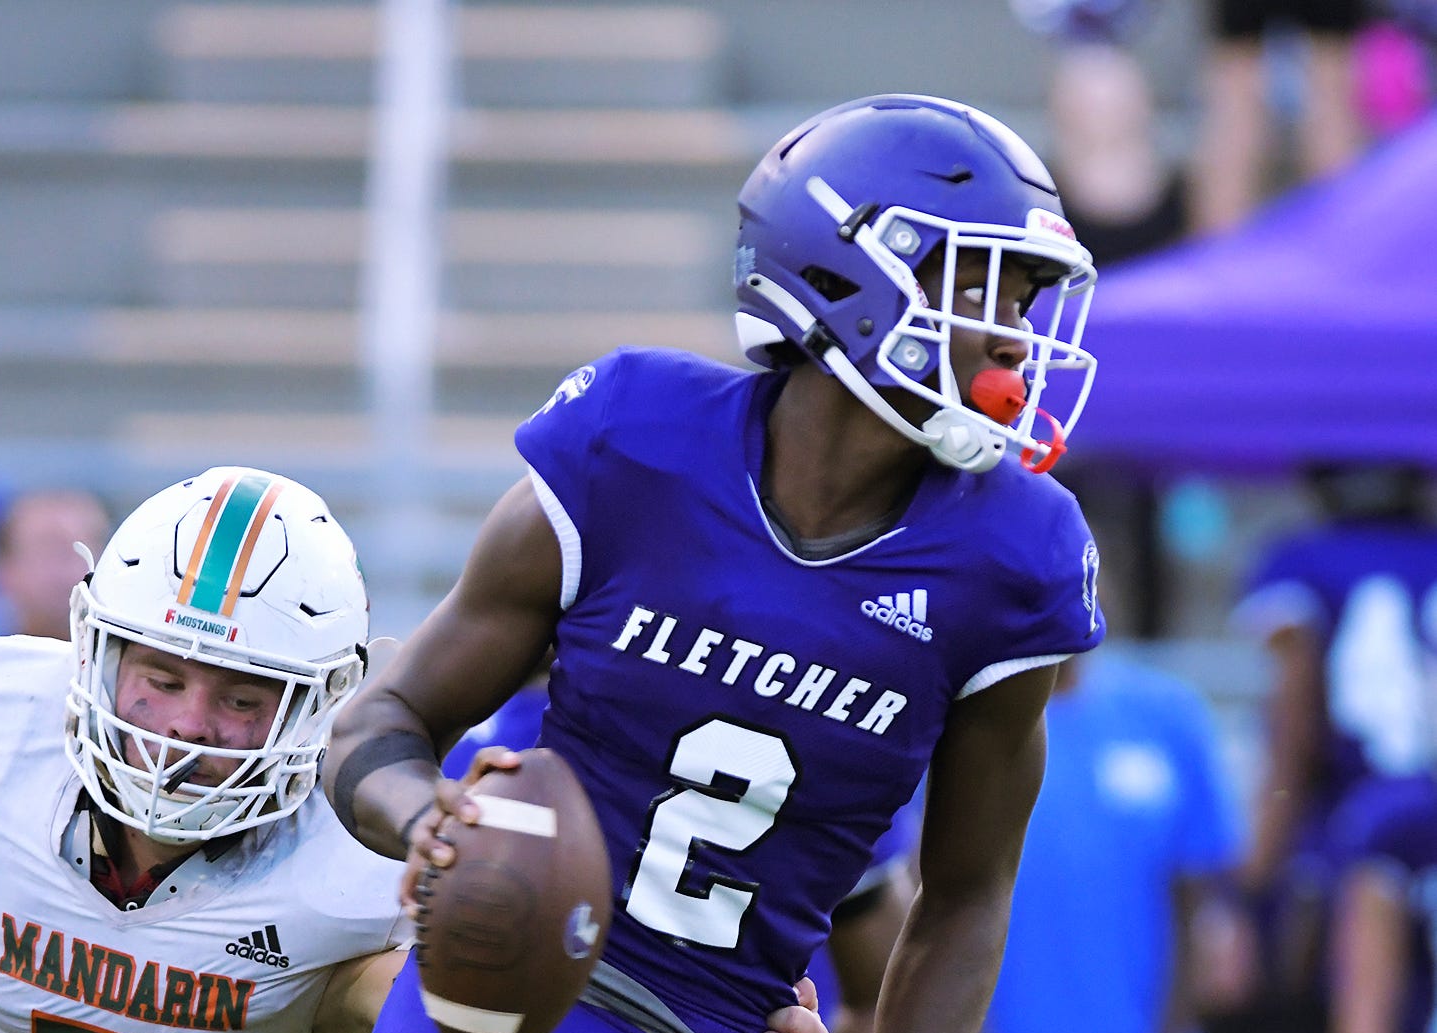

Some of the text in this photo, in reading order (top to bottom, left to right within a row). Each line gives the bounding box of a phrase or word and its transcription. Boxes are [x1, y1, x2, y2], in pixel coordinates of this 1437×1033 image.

[176, 614, 227, 636] MUSTANGS
[860, 600, 933, 642] adidas
[612, 606, 908, 735] FLETCHER
[625, 717, 797, 950] 2
[225, 942, 290, 969] adidas
